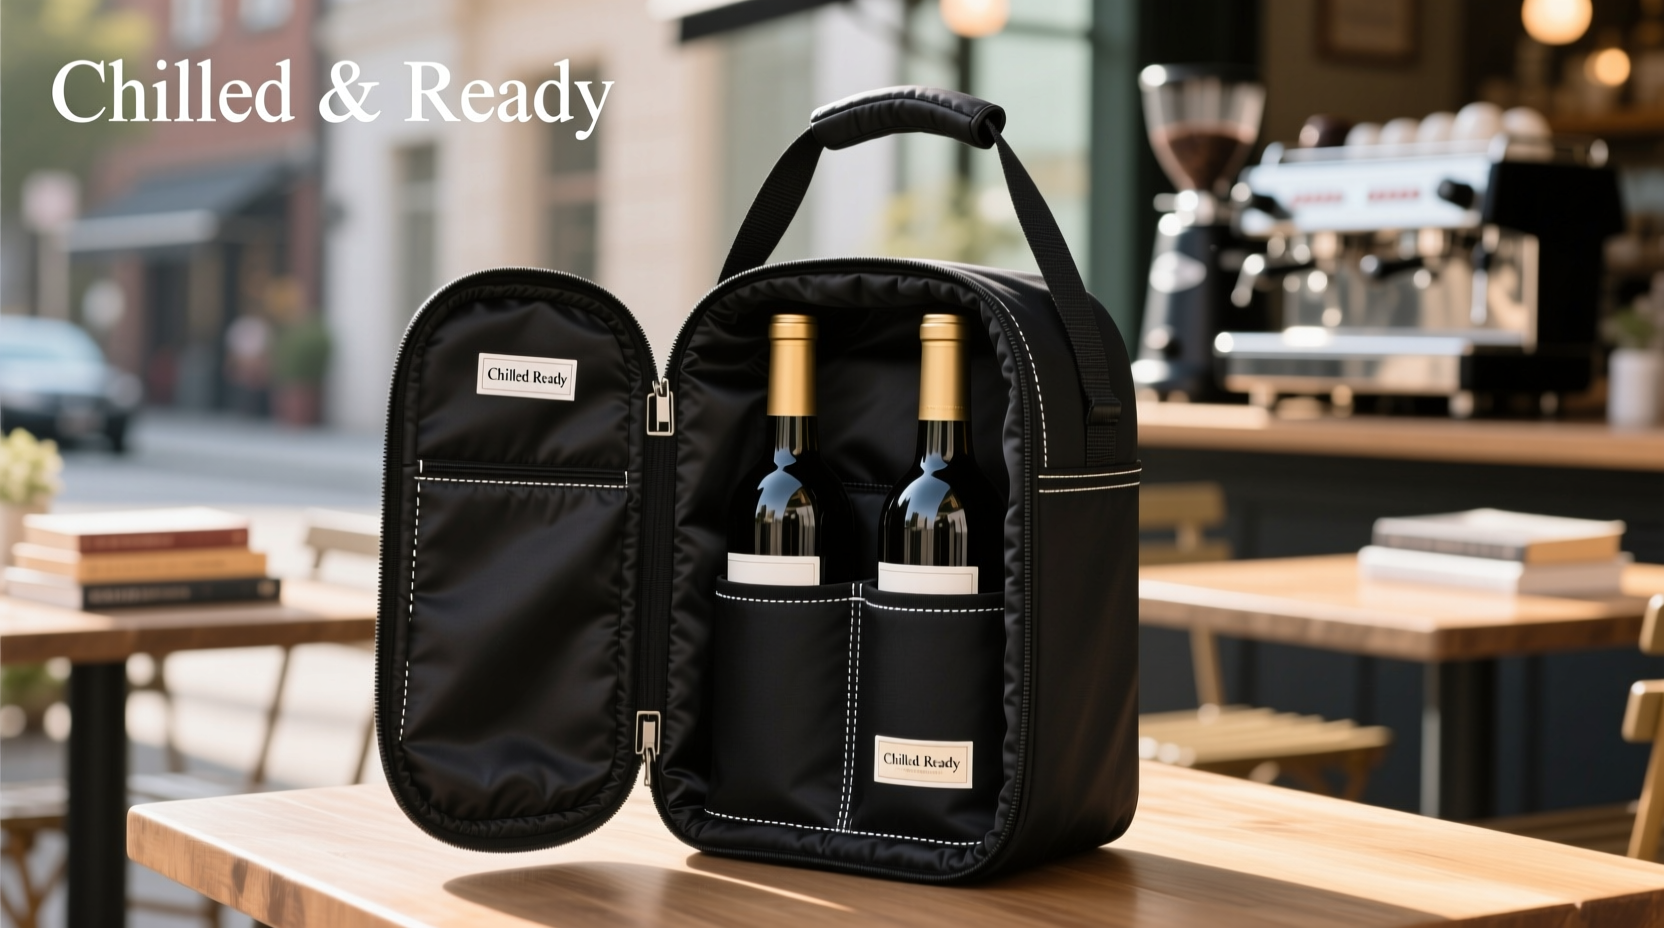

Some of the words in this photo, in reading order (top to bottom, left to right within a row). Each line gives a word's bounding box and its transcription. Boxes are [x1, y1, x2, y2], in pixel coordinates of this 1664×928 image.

[487, 366, 529, 383] Chilled
[533, 370, 568, 389] Ready
[924, 755, 961, 774] Ready
